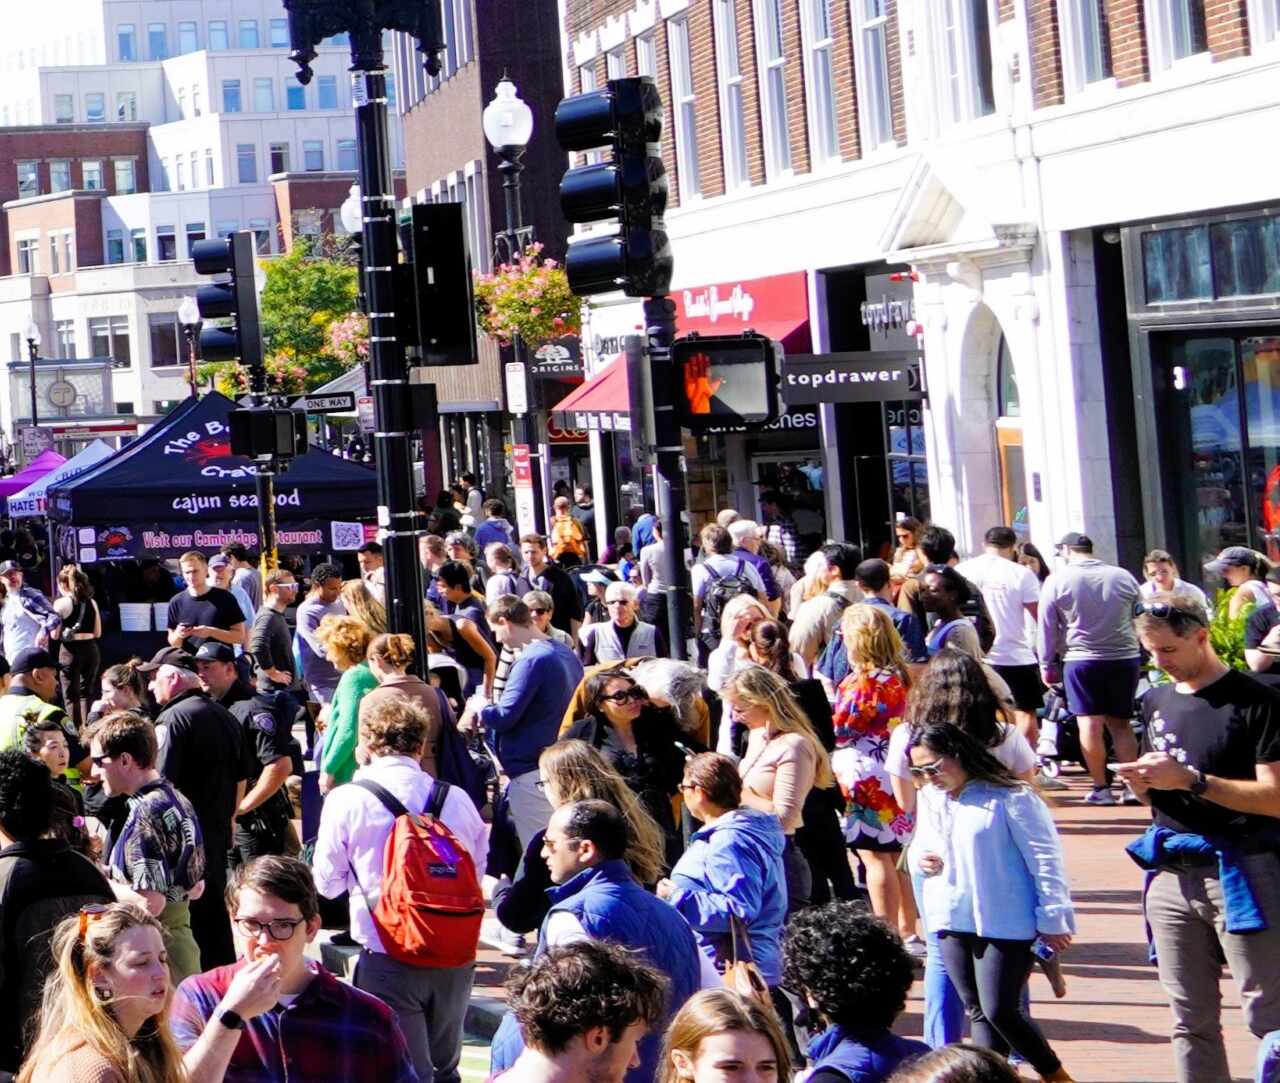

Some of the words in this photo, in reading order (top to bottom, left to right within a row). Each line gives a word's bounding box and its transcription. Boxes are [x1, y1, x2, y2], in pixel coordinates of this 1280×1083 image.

[787, 369, 901, 388] topdrawer
[306, 399, 326, 409] ONE
[328, 398, 348, 407] WAY
[164, 431, 201, 454] The
[201, 465, 257, 477] Crab
[10, 500, 35, 512] HATE
[172, 493, 221, 514] cajun
[229, 488, 300, 508] seaod
[143, 530, 170, 548] Visit
[172, 535, 192, 548] our
[194, 529, 258, 550] Cambridge
[275, 529, 323, 545] taurant
